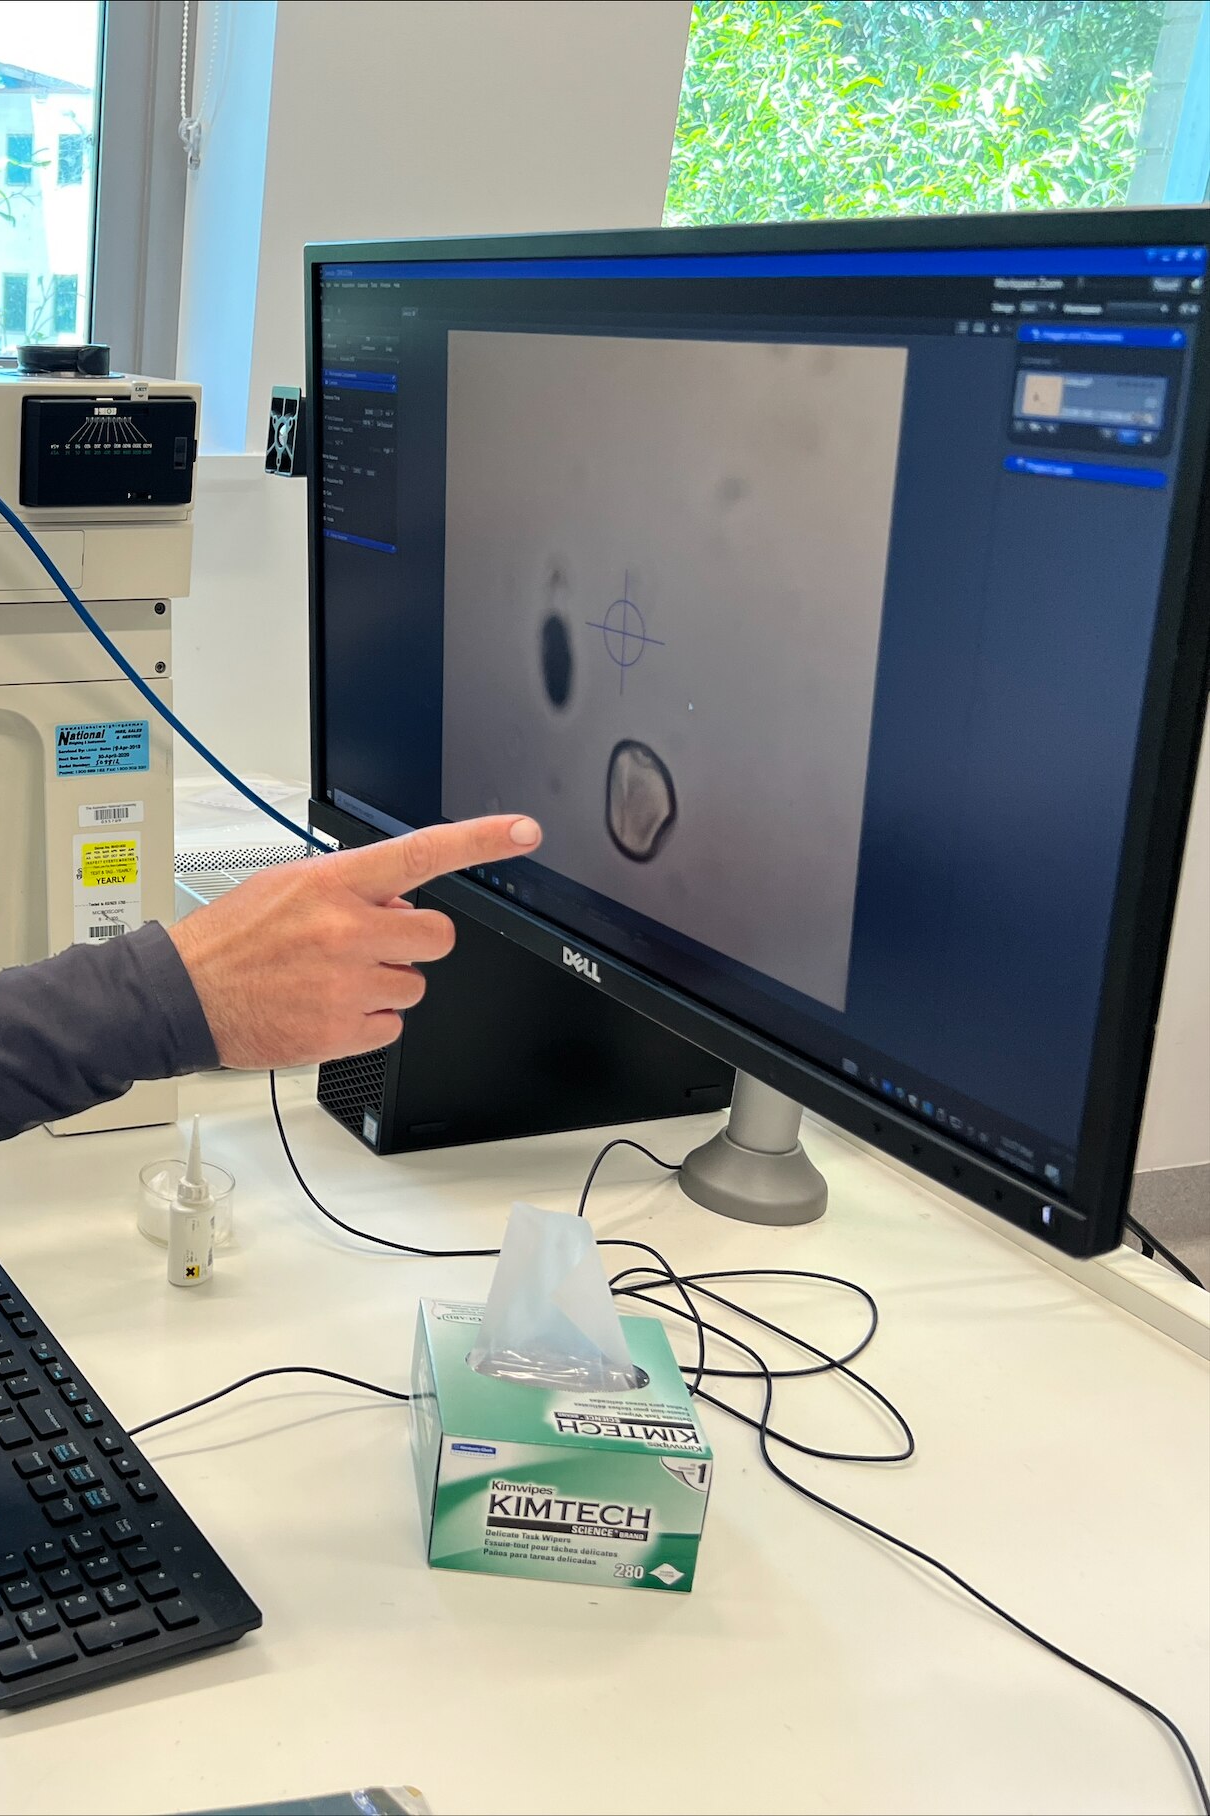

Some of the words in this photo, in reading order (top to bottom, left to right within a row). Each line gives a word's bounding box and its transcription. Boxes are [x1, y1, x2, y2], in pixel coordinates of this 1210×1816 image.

[58, 729, 105, 746] National
[96, 876, 126, 885] YEARLY
[562, 946, 601, 983] DELL
[584, 1415, 620, 1423] SCIENCE
[556, 1418, 699, 1444] KIMTECH
[647, 1441, 702, 1453] Kimwipes
[698, 1463, 707, 1483] 1
[492, 1480, 553, 1496] Kimwipes
[489, 1494, 651, 1528] KIMTECH
[485, 1529, 519, 1539] Delicate
[522, 1532, 539, 1541] Task
[542, 1534, 571, 1544] Wipers
[571, 1525, 614, 1537] SCIENCE
[619, 1532, 644, 1540] BRAND
[484, 1539, 529, 1550] Essuie-tout
[531, 1544, 550, 1552] pour
[551, 1544, 578, 1554] tâches
[509, 1551, 528, 1560] para
[529, 1553, 555, 1561] tareas
[557, 1556, 597, 1565] delicadas
[614, 1563, 644, 1579] 280
